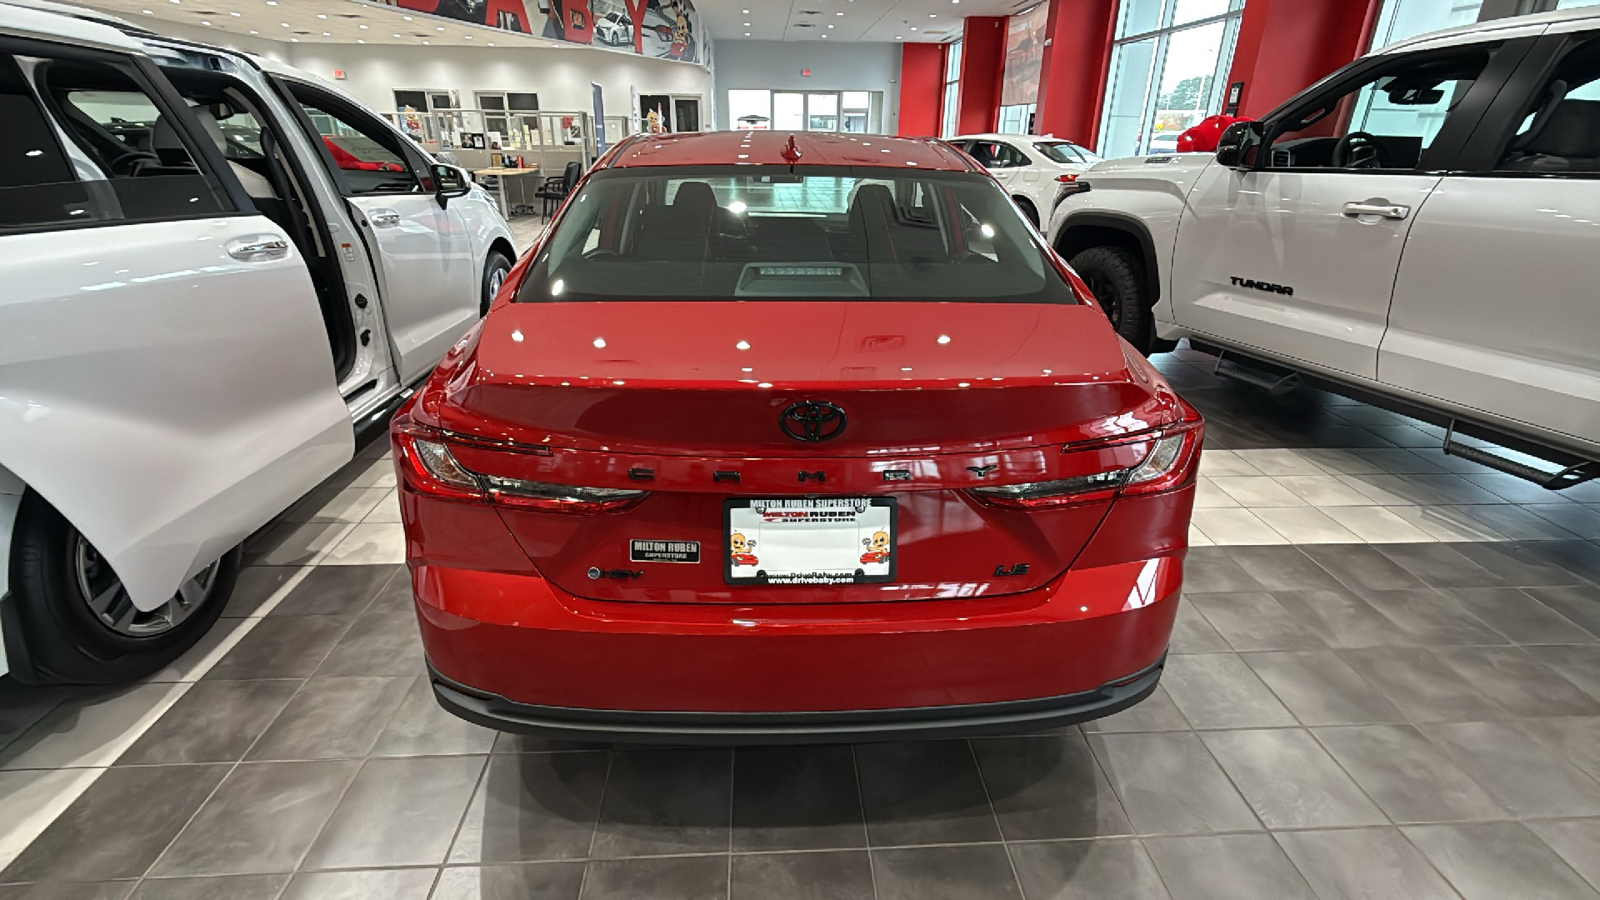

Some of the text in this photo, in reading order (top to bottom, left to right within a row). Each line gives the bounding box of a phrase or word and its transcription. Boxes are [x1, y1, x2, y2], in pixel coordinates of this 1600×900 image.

[1229, 276, 1294, 296] TUNDRA
[628, 465, 997, 482] CAMRY
[750, 498, 872, 508] MILTON RUBEN SUPERSTORE
[634, 541, 698, 553] MILTON RUBEN
[994, 563, 1030, 577] LE
[767, 577, 854, 585] www.drivebaby.com
